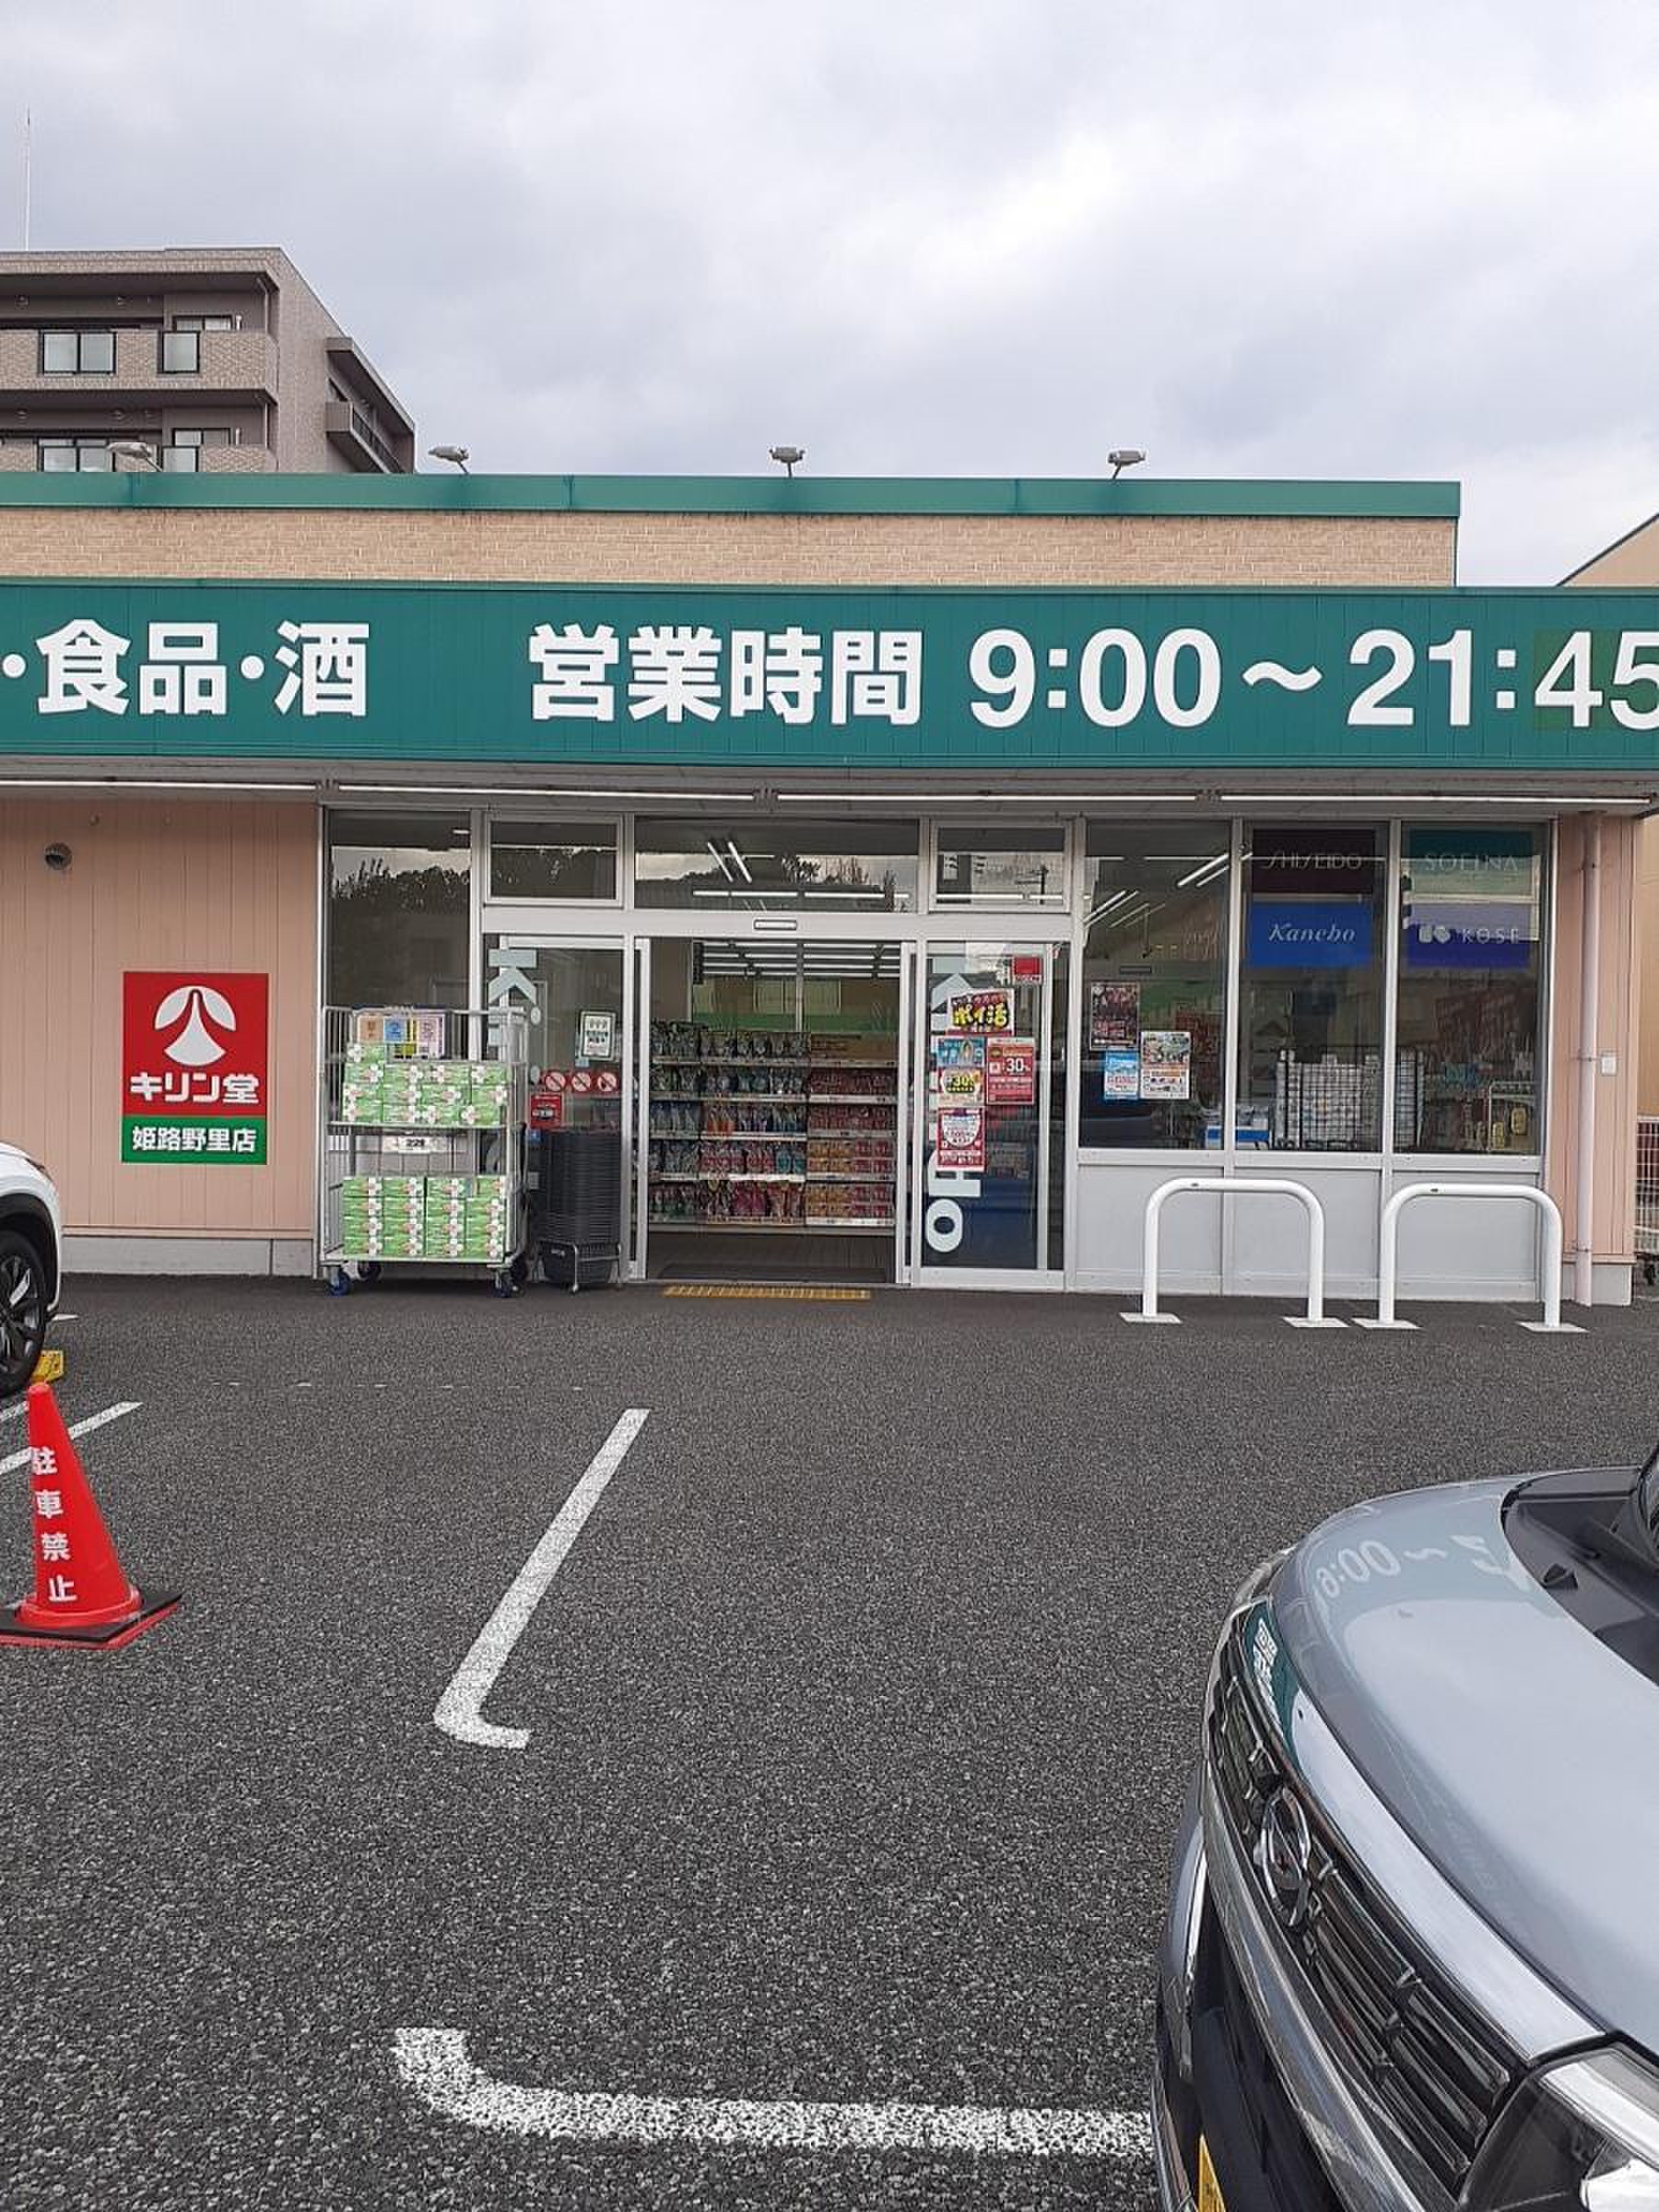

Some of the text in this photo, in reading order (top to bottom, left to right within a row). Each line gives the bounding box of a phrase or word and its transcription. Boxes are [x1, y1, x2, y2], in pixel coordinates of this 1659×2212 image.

[529, 624, 922, 724] 営業時間
[1268, 923, 1357, 942] Kanebo
[130, 1072, 259, 1103] キリン堂
[132, 1126, 256, 1152] 姫路野里店
[30, 1446, 77, 1603] 駐車禁止
